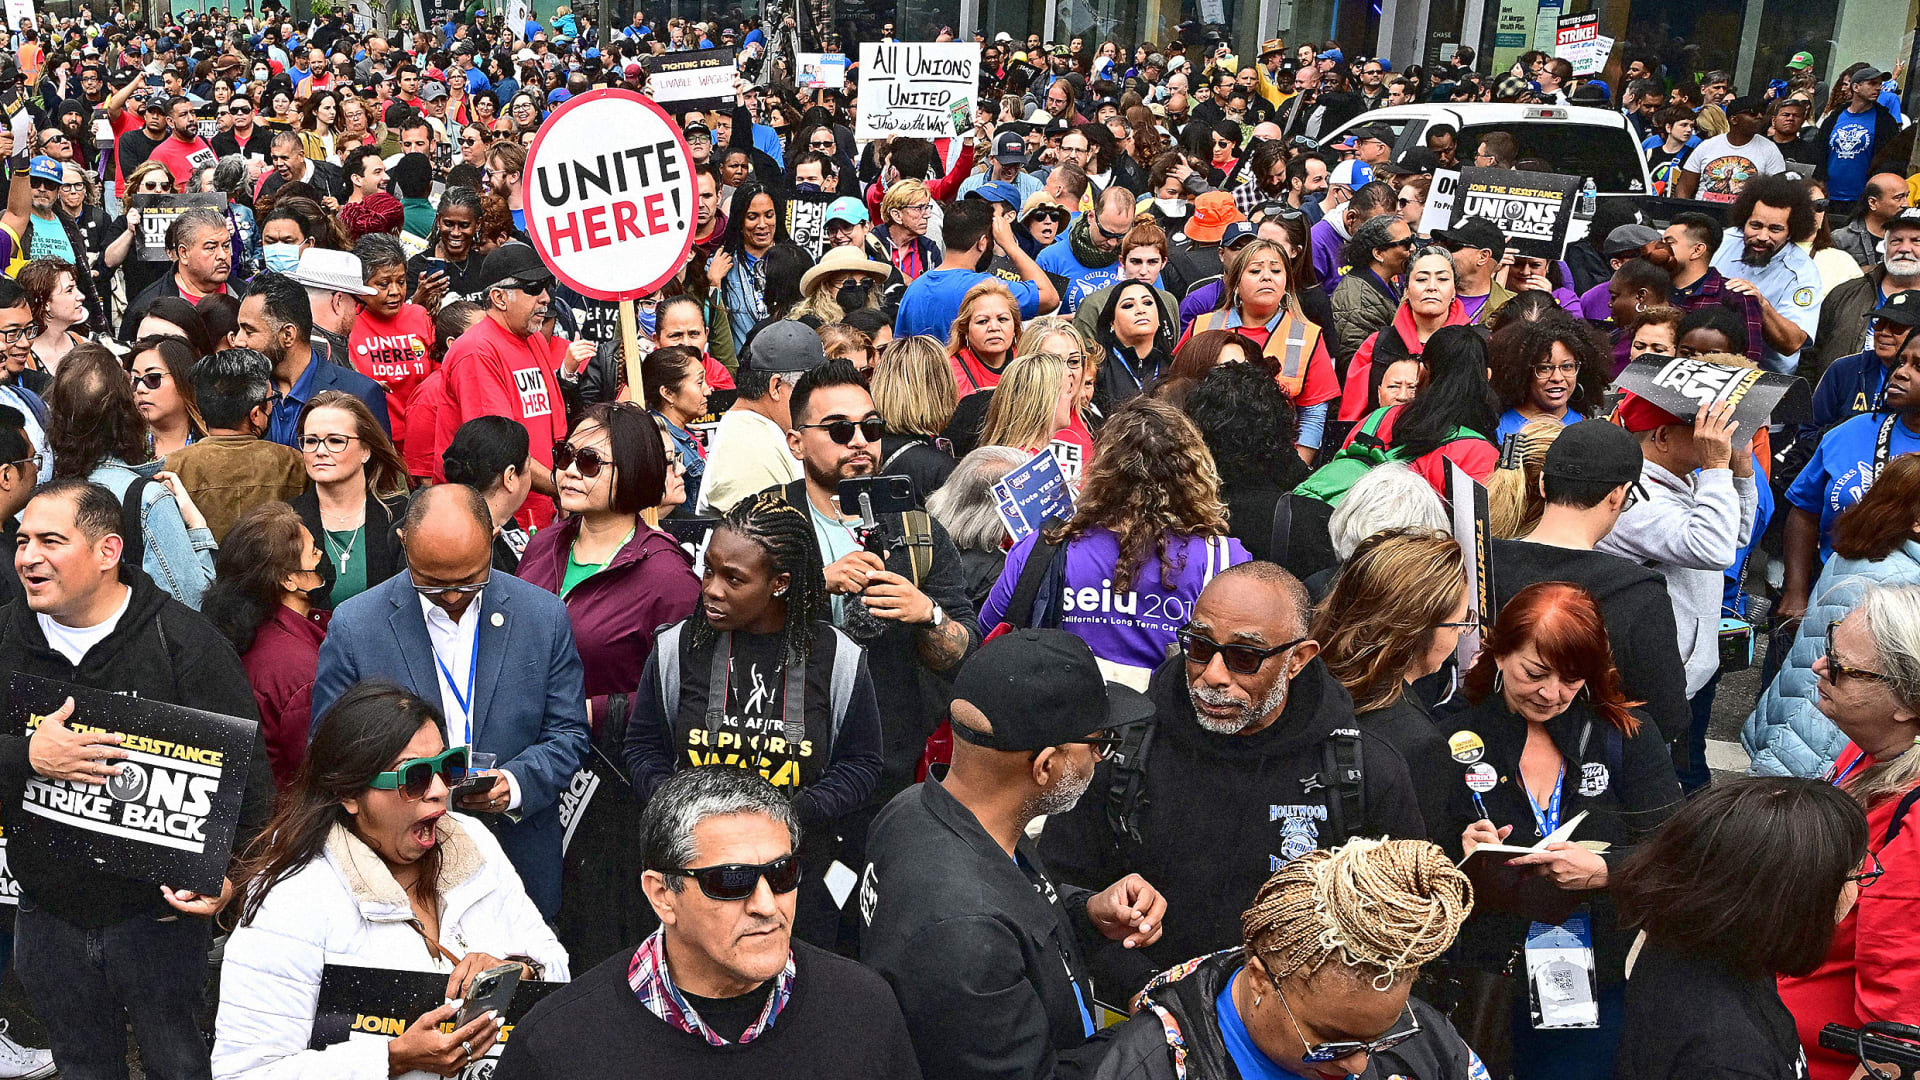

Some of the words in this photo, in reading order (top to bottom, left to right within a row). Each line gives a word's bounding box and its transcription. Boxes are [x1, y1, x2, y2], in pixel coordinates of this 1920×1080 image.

[1432, 31, 1452, 39] CHASE
[1558, 25, 1596, 45] STRIKE!
[661, 60, 698, 71] FIGHTING
[700, 58, 719, 67] FOR:
[873, 45, 897, 74] All
[888, 83, 951, 106] UNITED
[192, 150, 214, 164] ONE
[537, 140, 681, 207] UNITE
[1467, 183, 1487, 192] JOIN
[1489, 185, 1507, 194] THE
[1508, 186, 1564, 200] RESISTANCE
[1433, 200, 1442, 208] To
[1463, 196, 1561, 224] UNIONS
[546, 187, 685, 257] HERE!
[1511, 219, 1554, 235] BACK
[1084, 270, 1109, 281] GUILD
[369, 348, 415, 363] HERE
[372, 363, 410, 376] LOCAL
[413, 362, 425, 375] 11
[1018, 491, 1039, 507] Vote
[1830, 468, 1858, 512] WRITERS
[1040, 501, 1060, 518] Rent
[1475, 518, 1488, 619] FIGHTING
[1062, 578, 1138, 616] seiu
[1110, 617, 1133, 627] Long
[1135, 619, 1159, 630] Term
[23, 779, 113, 822] STRIKE
[558, 767, 595, 829] BACK
[121, 802, 207, 841] BACK
[1269, 804, 1328, 822] HOLLYWOOD
[352, 1013, 406, 1036] JOIN
